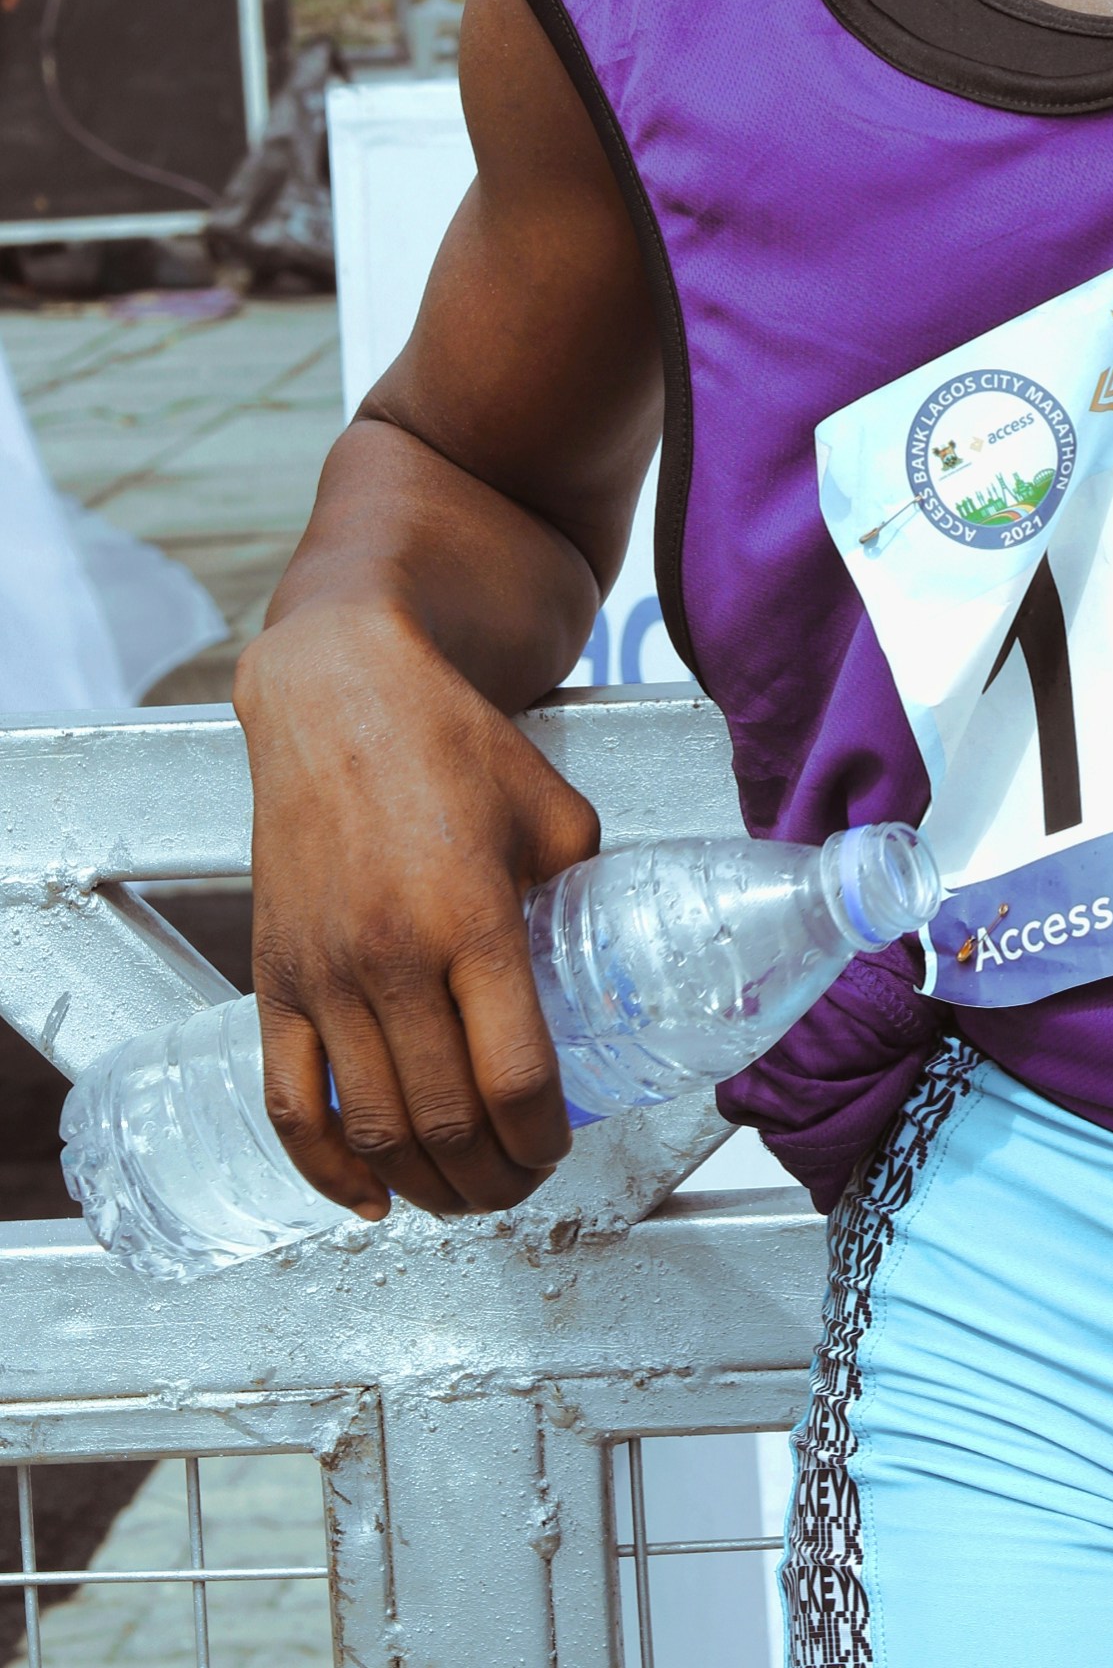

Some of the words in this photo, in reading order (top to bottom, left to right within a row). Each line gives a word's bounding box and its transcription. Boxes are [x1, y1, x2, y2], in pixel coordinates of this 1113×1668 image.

[921, 376, 977, 426] LAGOS
[980, 373, 1024, 391] CITY
[911, 427, 929, 483] BANK
[987, 412, 1035, 445] access
[1025, 385, 1074, 490] MARATHON
[918, 486, 977, 542] ACCESS
[1000, 515, 1044, 547] 2021
[975, 895, 1113, 972] Access
